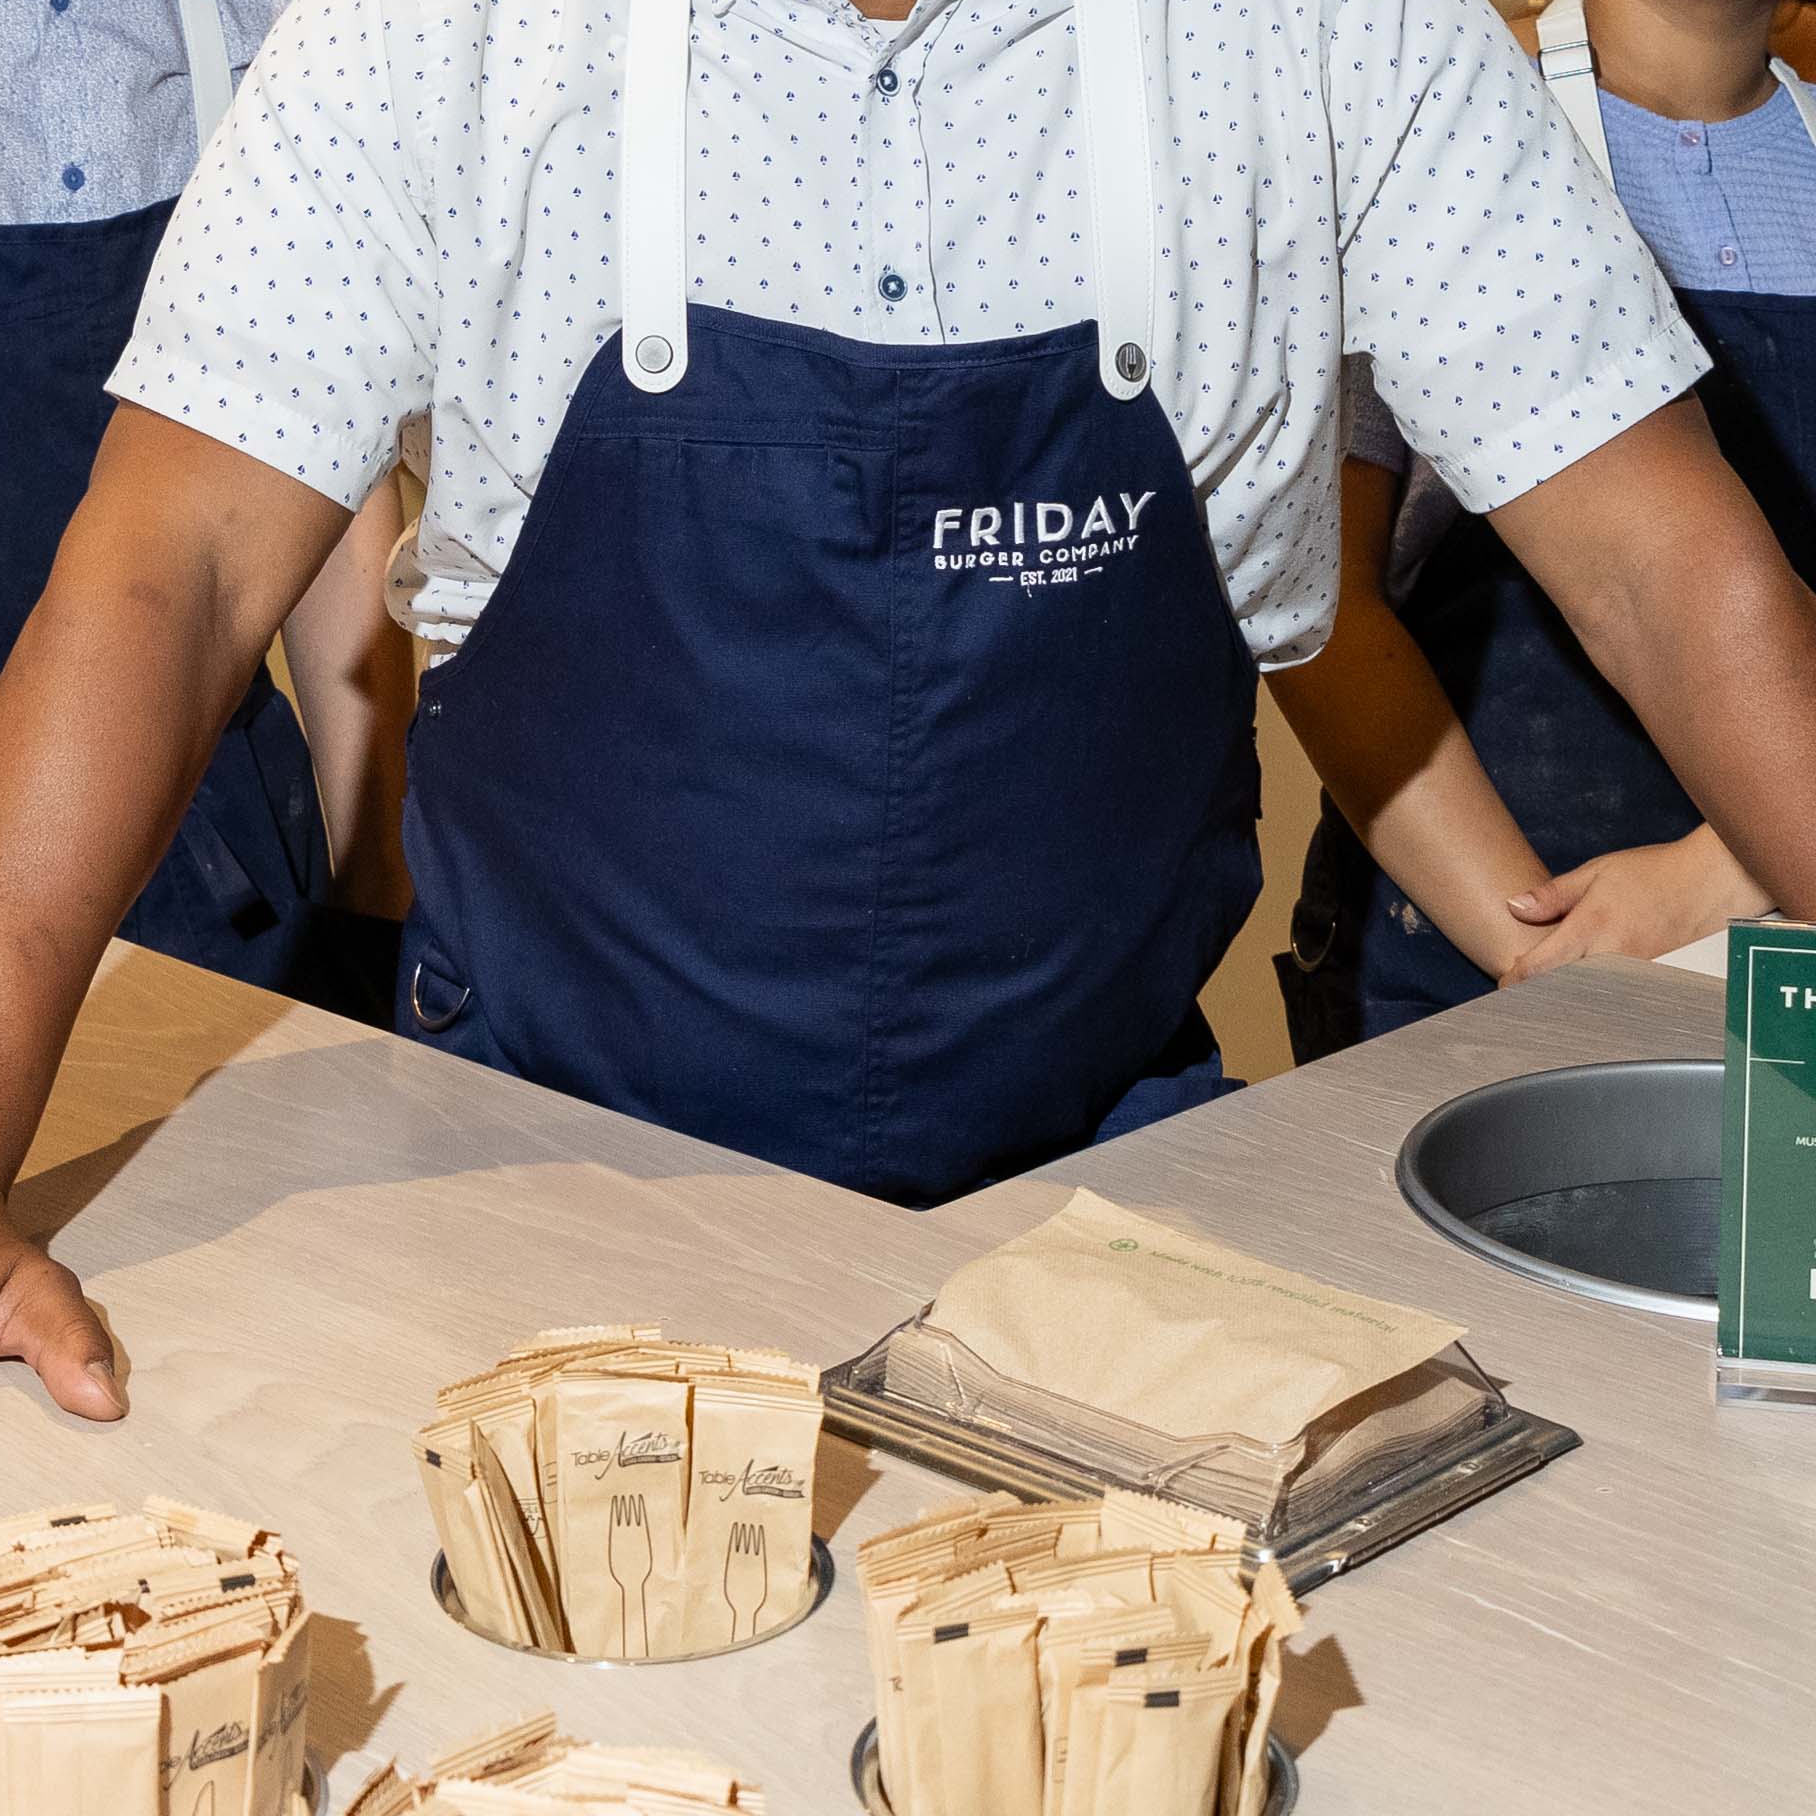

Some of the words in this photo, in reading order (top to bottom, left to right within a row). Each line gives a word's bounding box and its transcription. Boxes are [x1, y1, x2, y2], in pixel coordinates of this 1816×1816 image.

[933, 492, 1156, 548] FRIDAY
[934, 551, 1024, 570] BURGER
[1040, 535, 1139, 564] COMPANY
[1020, 570, 1047, 586] EST.
[1050, 567, 1078, 584] 2021
[570, 1449, 611, 1466] Table
[698, 1470, 736, 1485] Table
